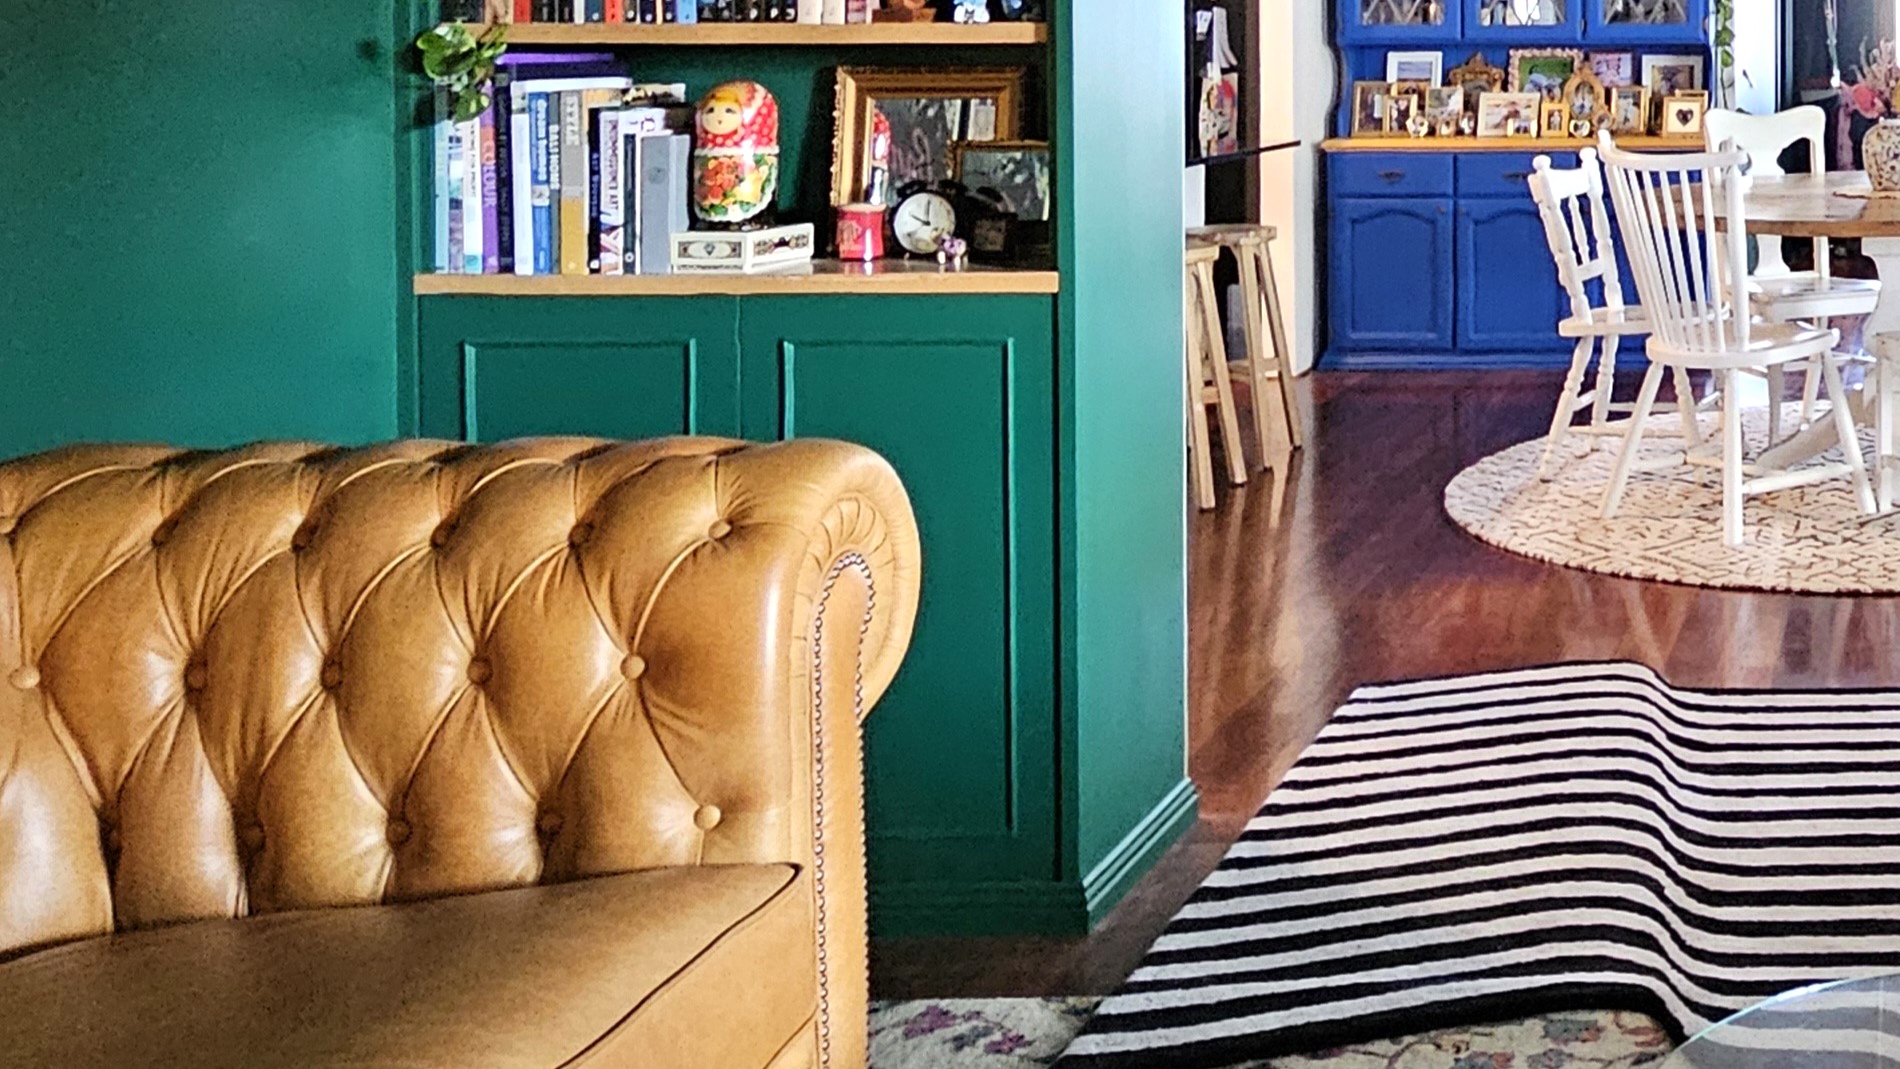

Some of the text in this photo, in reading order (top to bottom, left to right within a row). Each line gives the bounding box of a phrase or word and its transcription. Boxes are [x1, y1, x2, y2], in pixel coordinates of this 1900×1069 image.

[549, 124, 559, 153] BALI
[565, 95, 579, 146] STYLE
[483, 141, 497, 209] COLOUR
